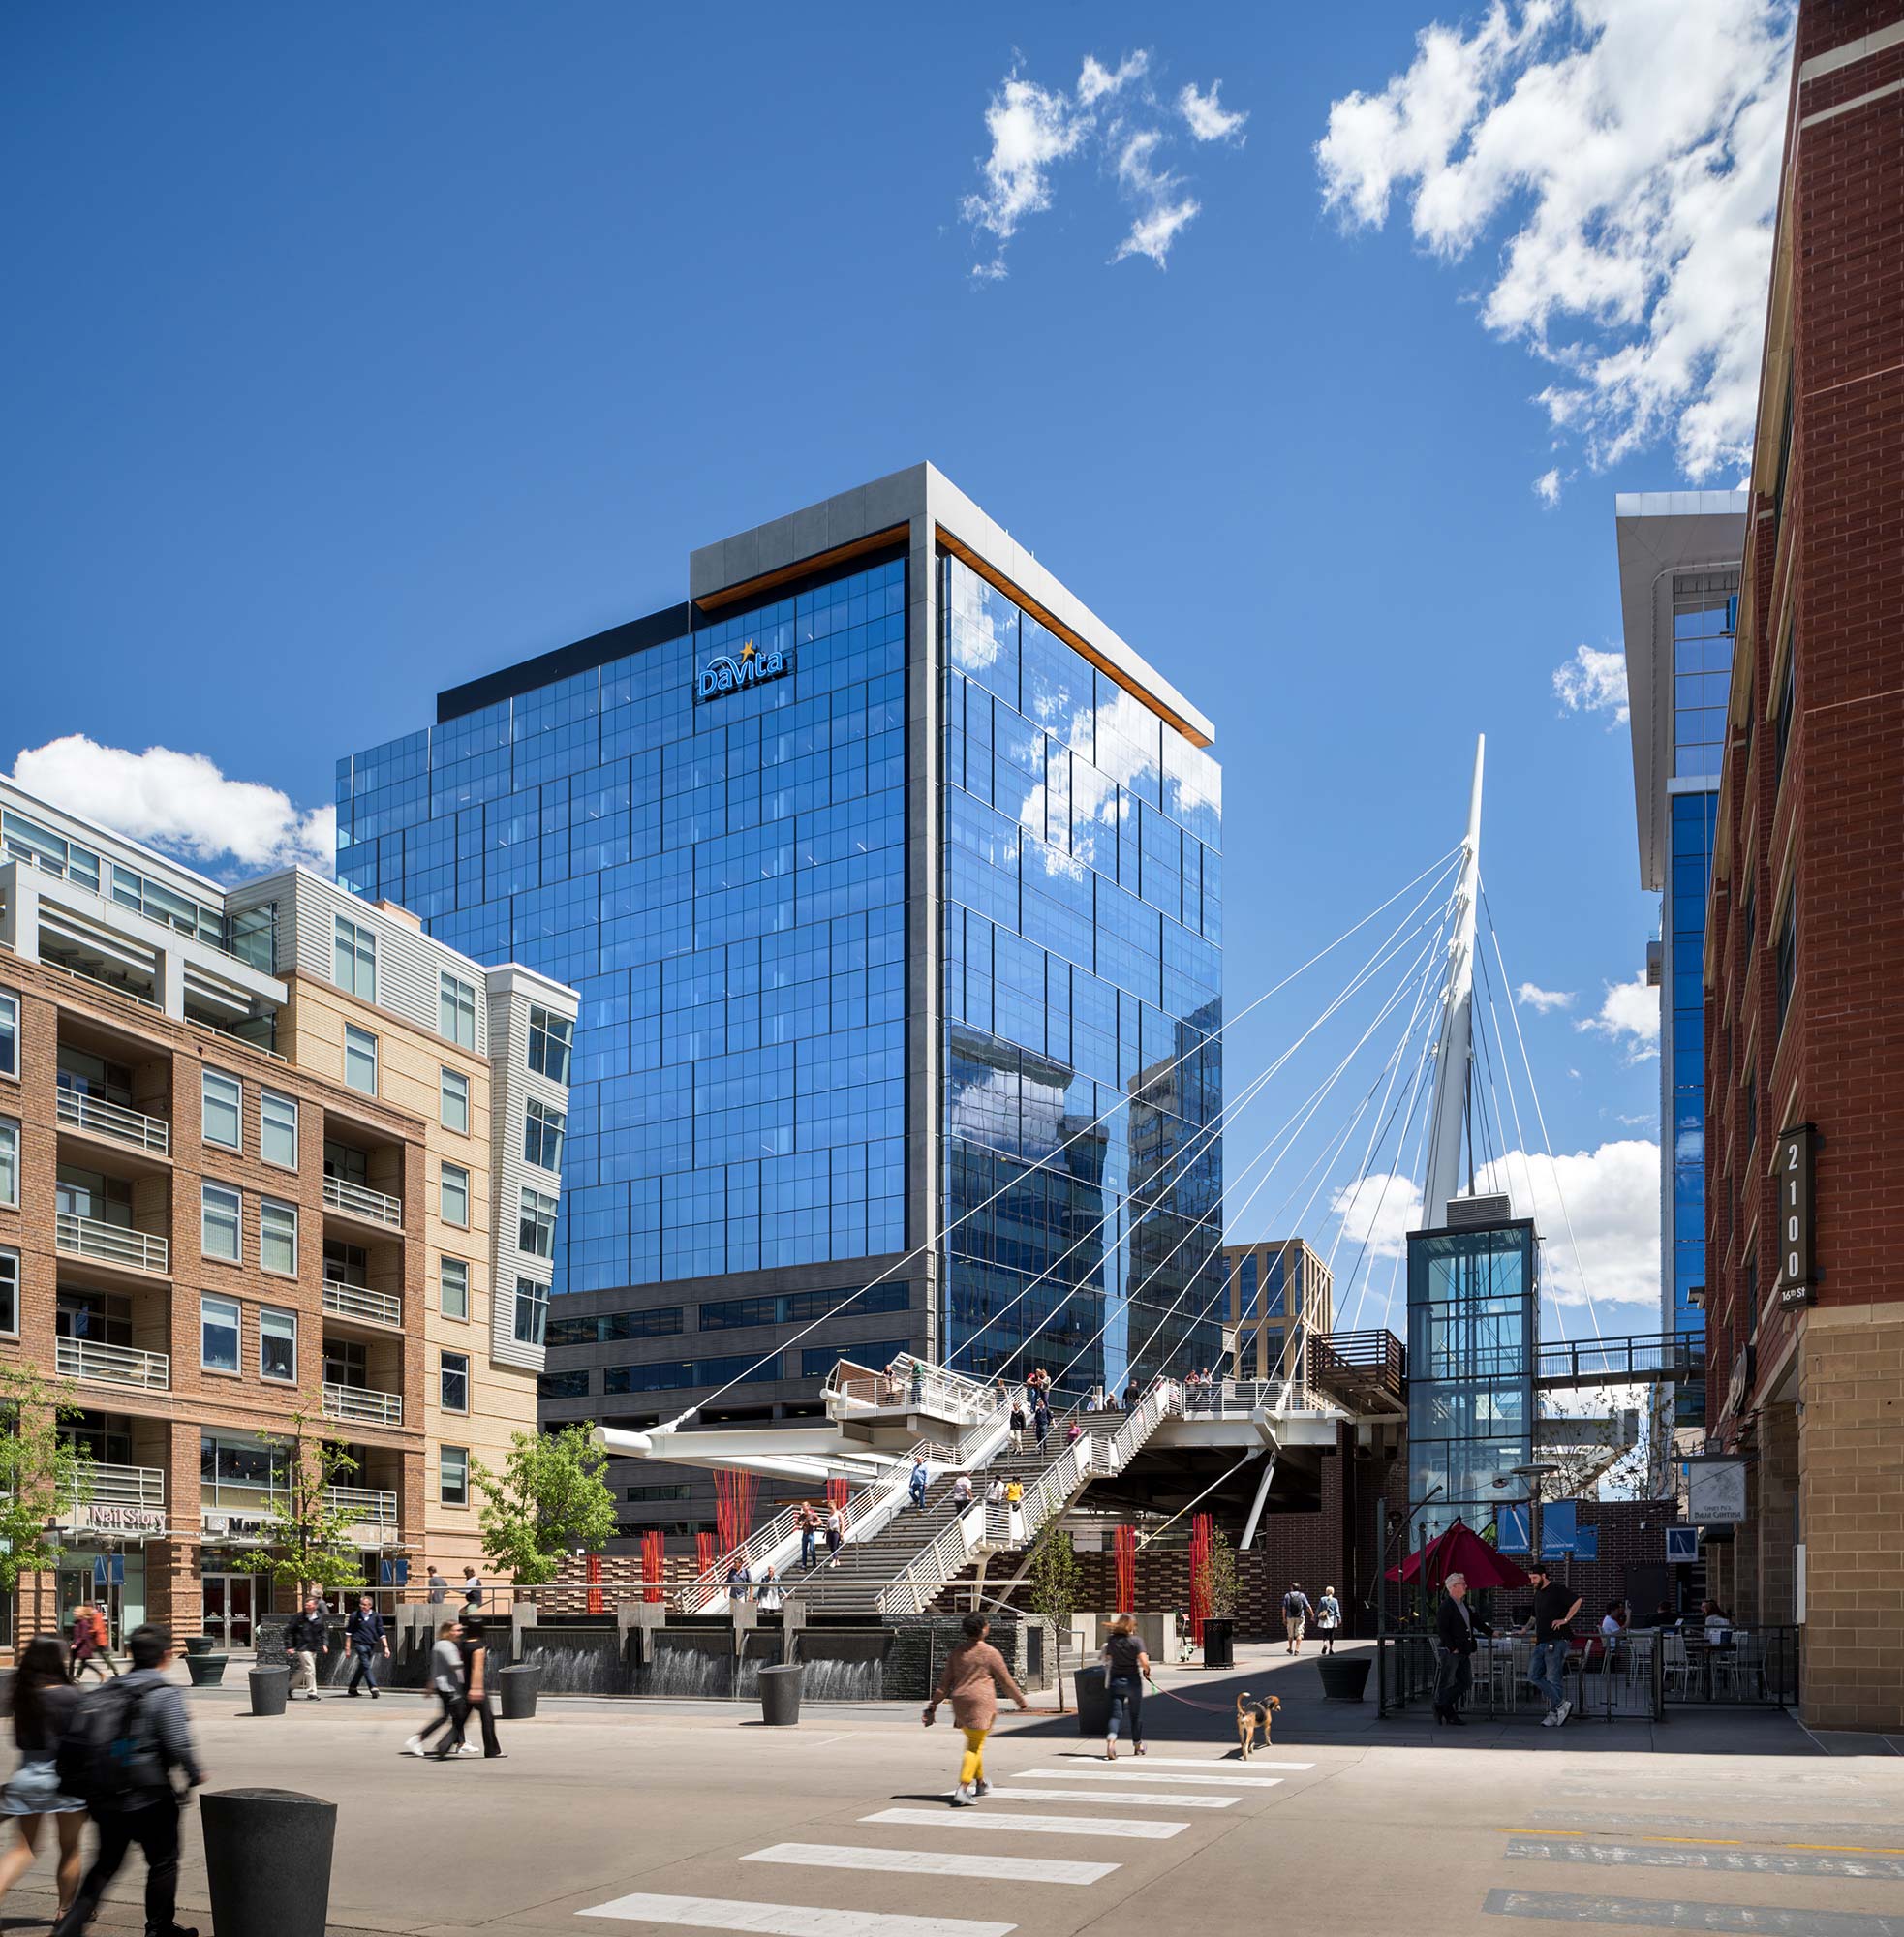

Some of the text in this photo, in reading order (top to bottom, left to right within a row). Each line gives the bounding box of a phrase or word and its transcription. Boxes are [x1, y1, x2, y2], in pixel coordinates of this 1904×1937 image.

[698, 640, 783, 697] DaVita
[1788, 1144, 1799, 1277] 2100
[1797, 1286, 1806, 1298] St
[90, 1506, 167, 1530] Nail Story
